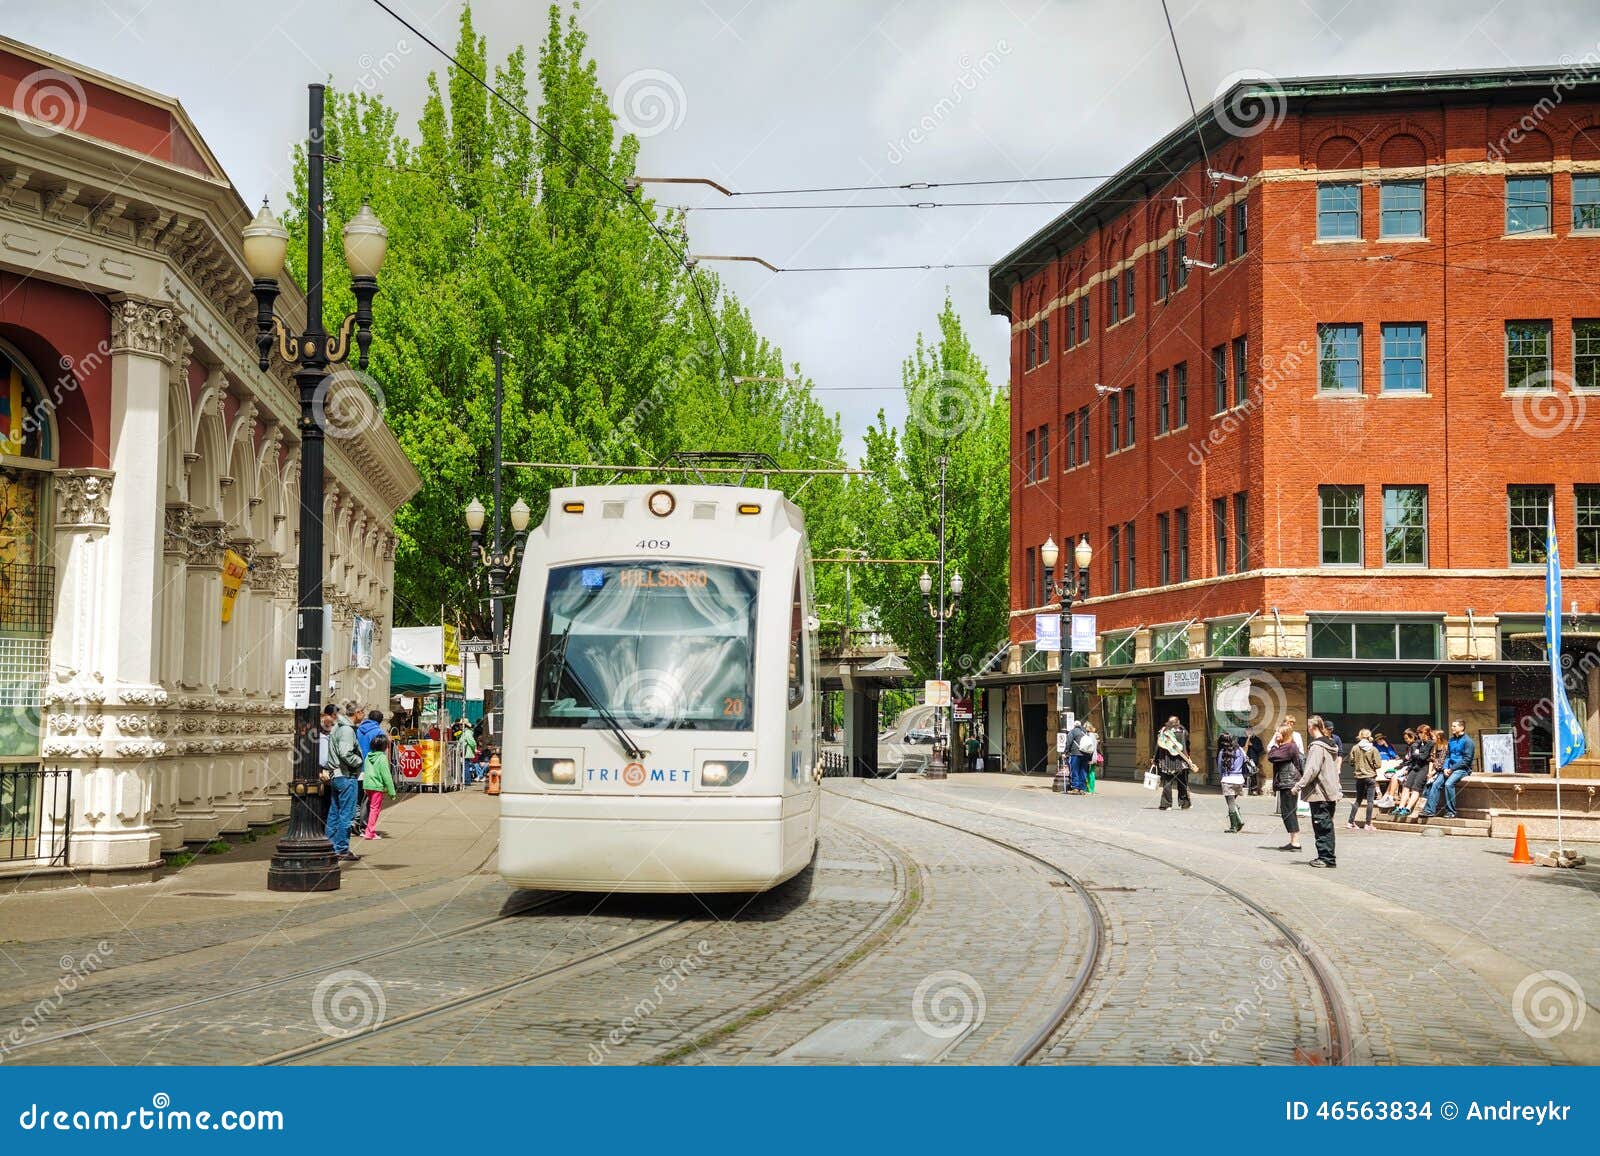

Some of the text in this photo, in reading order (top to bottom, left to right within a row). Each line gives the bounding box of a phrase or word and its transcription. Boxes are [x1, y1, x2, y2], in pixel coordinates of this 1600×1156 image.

[635, 539, 671, 550] 409
[620, 569, 708, 589] HILLSBORO
[723, 697, 744, 717] 20
[400, 758, 421, 769] STOP
[587, 769, 691, 783] TRI MET
